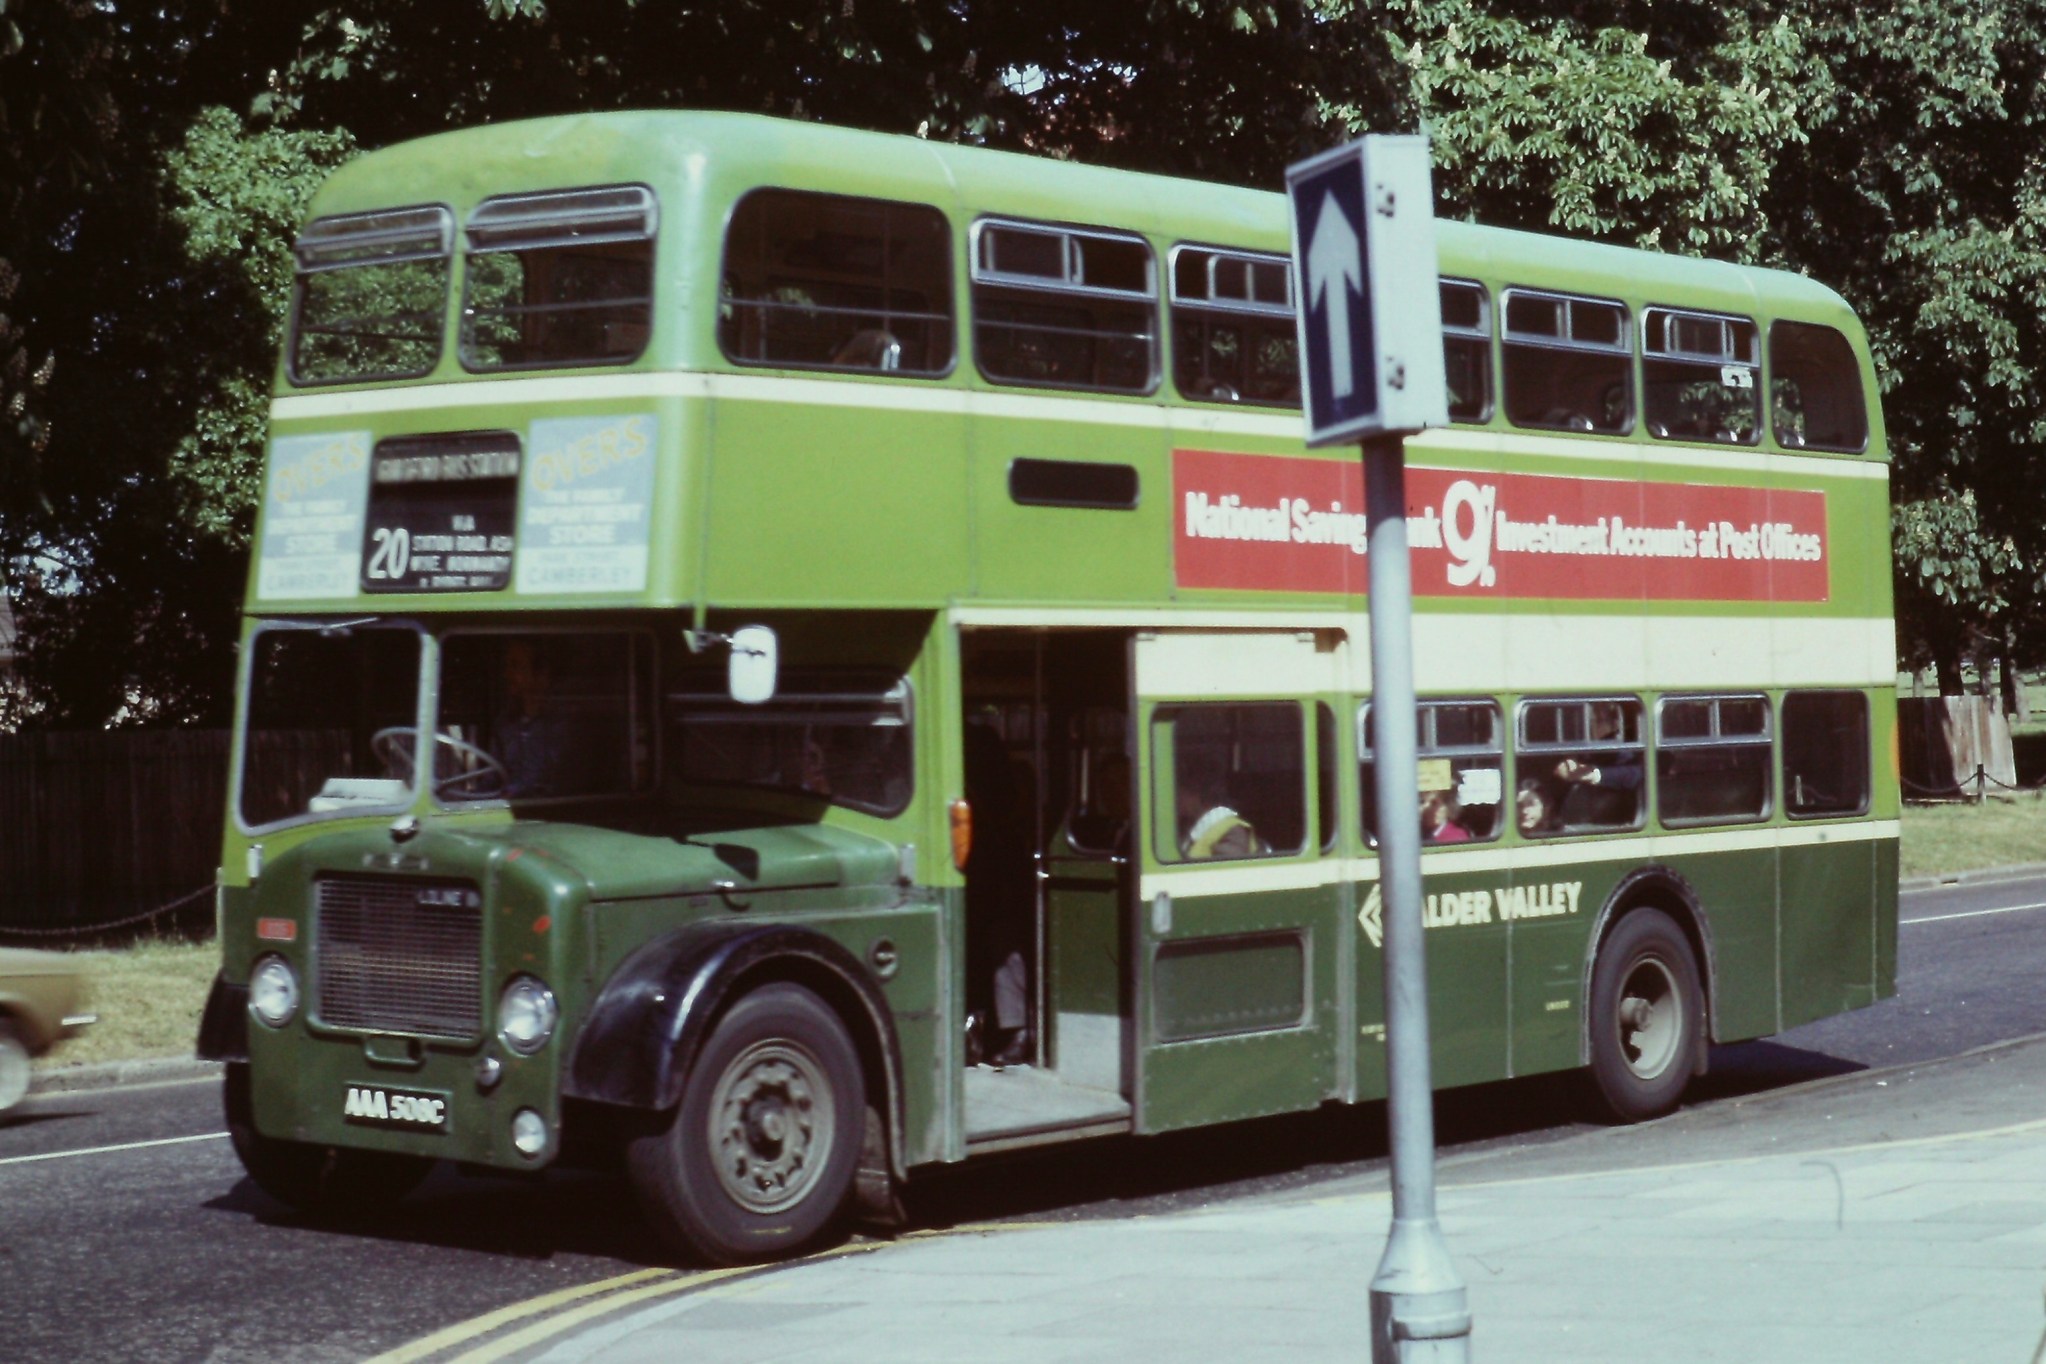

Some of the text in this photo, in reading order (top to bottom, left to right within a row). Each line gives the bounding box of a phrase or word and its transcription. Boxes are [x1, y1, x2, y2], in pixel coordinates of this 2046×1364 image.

[273, 438, 365, 502] OVERS
[531, 417, 647, 491] OVERS
[549, 524, 617, 545] STORE
[1185, 491, 1290, 542] National
[1291, 498, 1368, 555] Saving
[1496, 510, 1609, 555] Investment
[1610, 516, 1697, 558] Accounts
[1698, 522, 1719, 558] at
[1719, 521, 1761, 560] Post
[1761, 523, 1822, 561] Offices
[368, 528, 410, 579] 20
[1494, 881, 1583, 921] VALLEY
[344, 1088, 389, 1120] AAA
